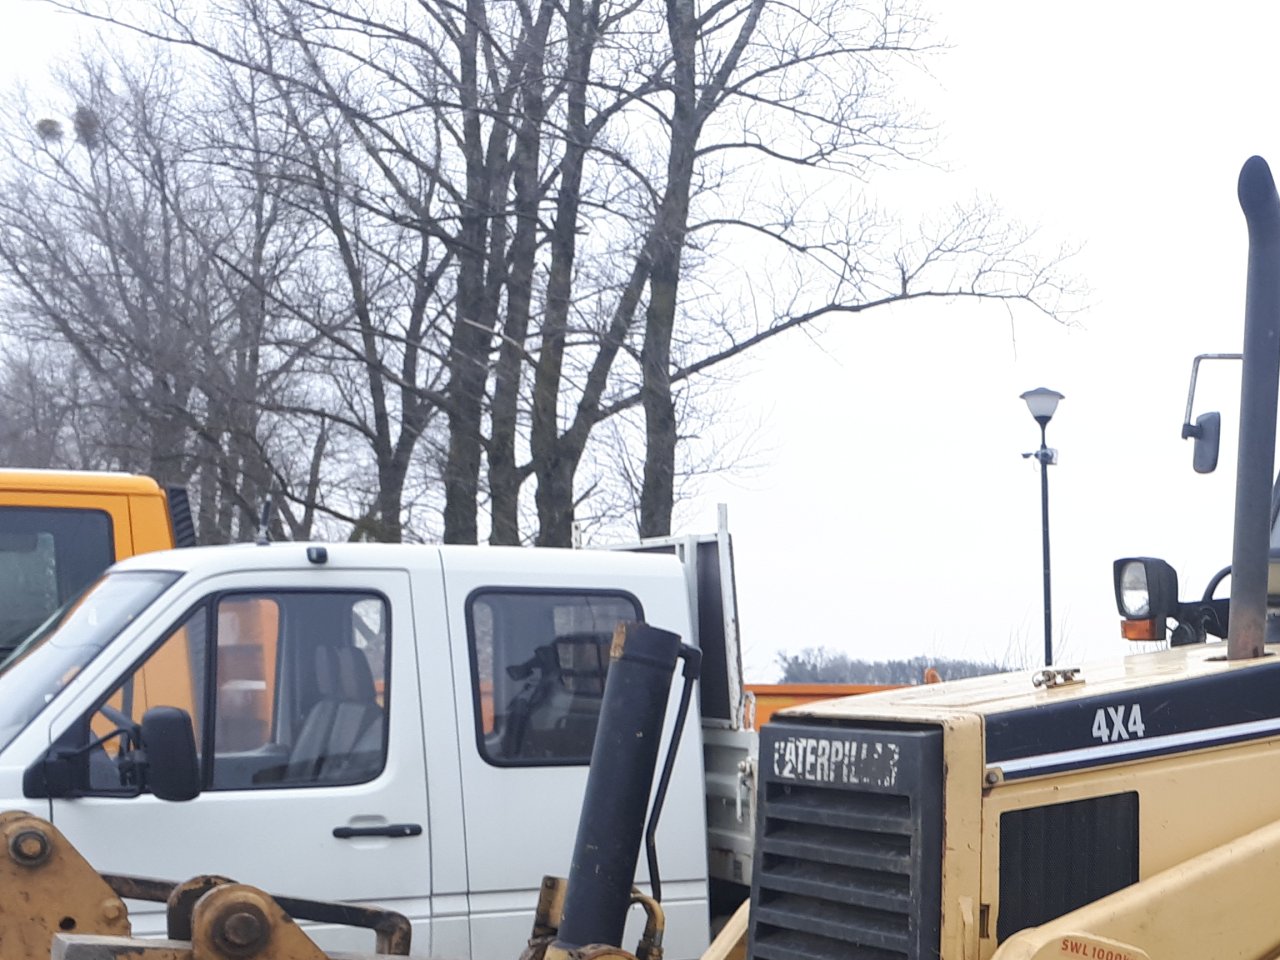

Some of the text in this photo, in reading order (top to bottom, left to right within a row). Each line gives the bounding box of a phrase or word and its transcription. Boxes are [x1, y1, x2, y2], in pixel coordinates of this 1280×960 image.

[1092, 703, 1146, 743] 4X4
[774, 737, 900, 788] CATERPILR
[1061, 939, 1089, 957] SWL
